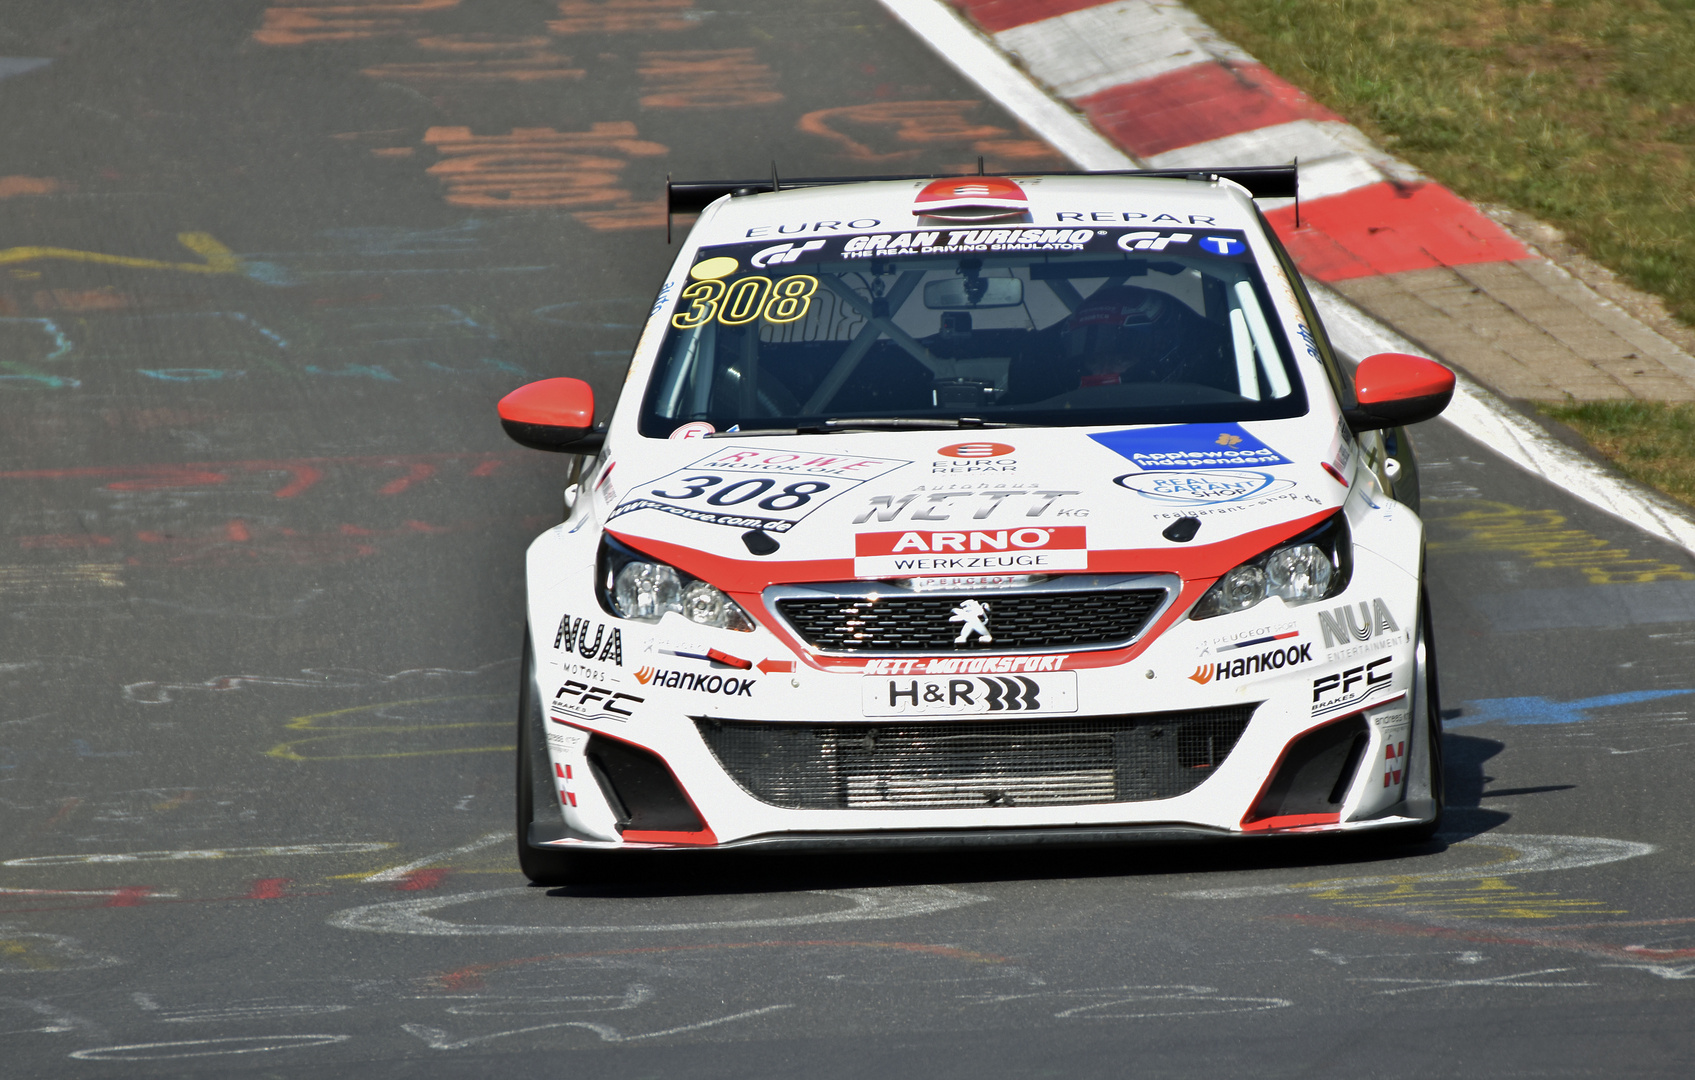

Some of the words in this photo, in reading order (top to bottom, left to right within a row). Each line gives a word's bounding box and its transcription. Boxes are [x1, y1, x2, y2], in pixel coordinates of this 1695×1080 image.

[745, 218, 882, 238] EURO
[1055, 211, 1217, 227] REPAR
[843, 232, 940, 251] GRAN
[876, 248, 919, 257] REAL
[921, 244, 988, 254] DRIVING
[990, 242, 1085, 251] SIMULATOR
[1207, 237, 1237, 254] T
[671, 274, 819, 329] 308
[718, 451, 883, 471] ROWE
[932, 459, 1018, 467] EURO
[1133, 448, 1273, 461] Applewood
[1138, 454, 1281, 466] Independent
[704, 461, 800, 471] MOTOR
[806, 467, 846, 475] OIL
[931, 466, 1017, 474] REPAR
[912, 482, 1040, 492] Autohaus
[1153, 477, 1208, 487] REAL
[1153, 481, 1256, 493] GARANT
[651, 475, 831, 511] 308
[1190, 487, 1247, 498] SHOP
[852, 490, 1083, 525] NETT
[1056, 508, 1090, 518] KG
[1152, 490, 1323, 520] realgarant-shop.de
[895, 554, 1049, 570] WERKZEUGE
[926, 576, 1016, 585] PEUGEOT
[1318, 597, 1400, 648] NUA
[553, 614, 623, 667] NUA
[1213, 626, 1271, 644] PEUGEOT
[1327, 636, 1403, 663] ENTERTAINMENT
[562, 664, 606, 682] MOTORS
[863, 655, 1070, 674] NETT-MOTORSPORT
[1312, 655, 1393, 703] PFC
[555, 680, 645, 716] PFC
[889, 680, 976, 706] H&R
[1311, 693, 1355, 710] BRAKES
[551, 700, 587, 713] BRAKES
